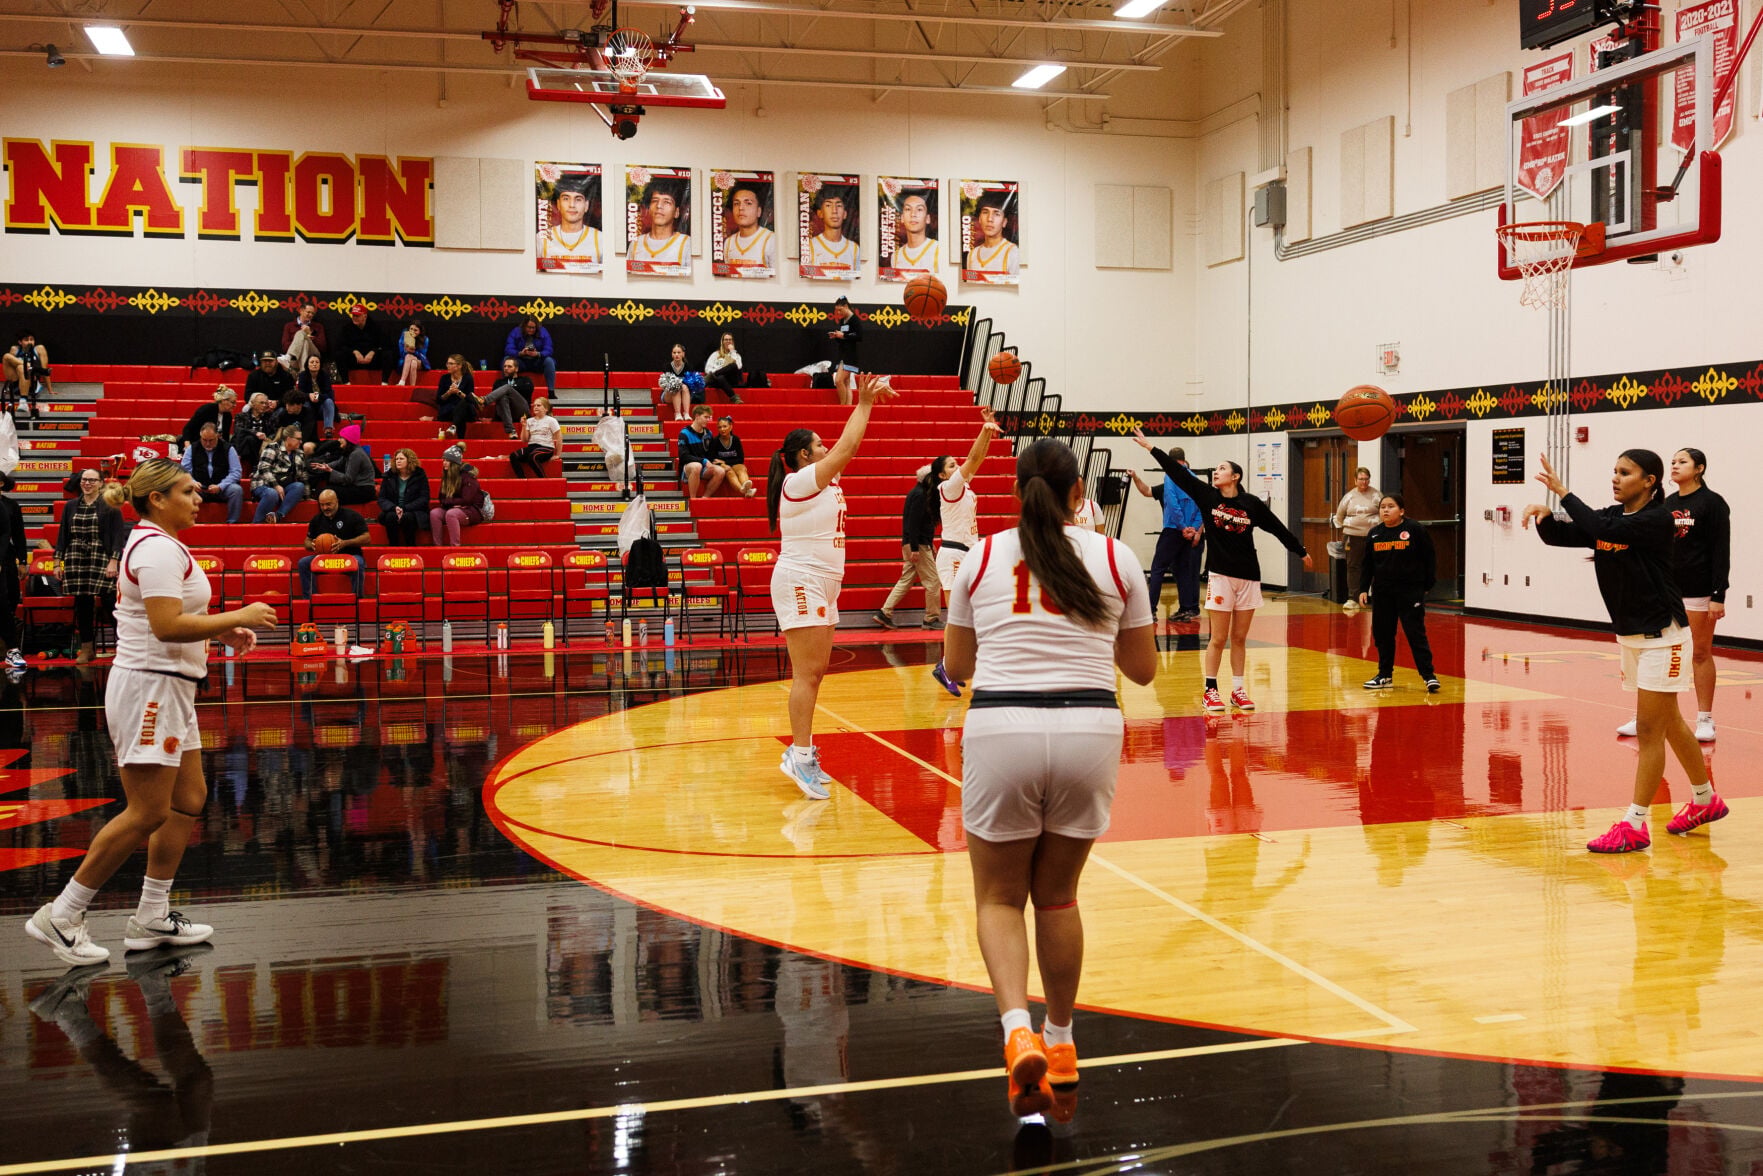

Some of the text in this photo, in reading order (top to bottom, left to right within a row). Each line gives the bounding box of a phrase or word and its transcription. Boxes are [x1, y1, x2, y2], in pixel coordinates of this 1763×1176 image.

[1679, 0, 1734, 31] 2020-2021
[1694, 22, 1719, 37] FOOTBALL
[1541, 66, 1555, 76] TRACK
[2, 137, 435, 247] NATION
[538, 199, 549, 240] DUNN
[628, 203, 638, 243] ROMO
[713, 191, 725, 262] BERTUCCI
[800, 191, 811, 265] SHERIDAN
[888, 207, 896, 253] LOVEJOY
[962, 215, 971, 253] ROMO
[20, 462, 69, 470] THE CHIEFS
[257, 559, 279, 570] CHIEFS
[324, 559, 345, 570] CHIEFS
[391, 558, 411, 569] CHIEFS
[455, 557, 475, 568] CHIEFS
[520, 556, 540, 566] CHIEFS
[575, 555, 595, 566] CHIEFS
[692, 553, 712, 563] CHIEFS
[748, 552, 767, 562] CHIEFS
[794, 586, 808, 615] NATION
[140, 702, 158, 746] NATION
